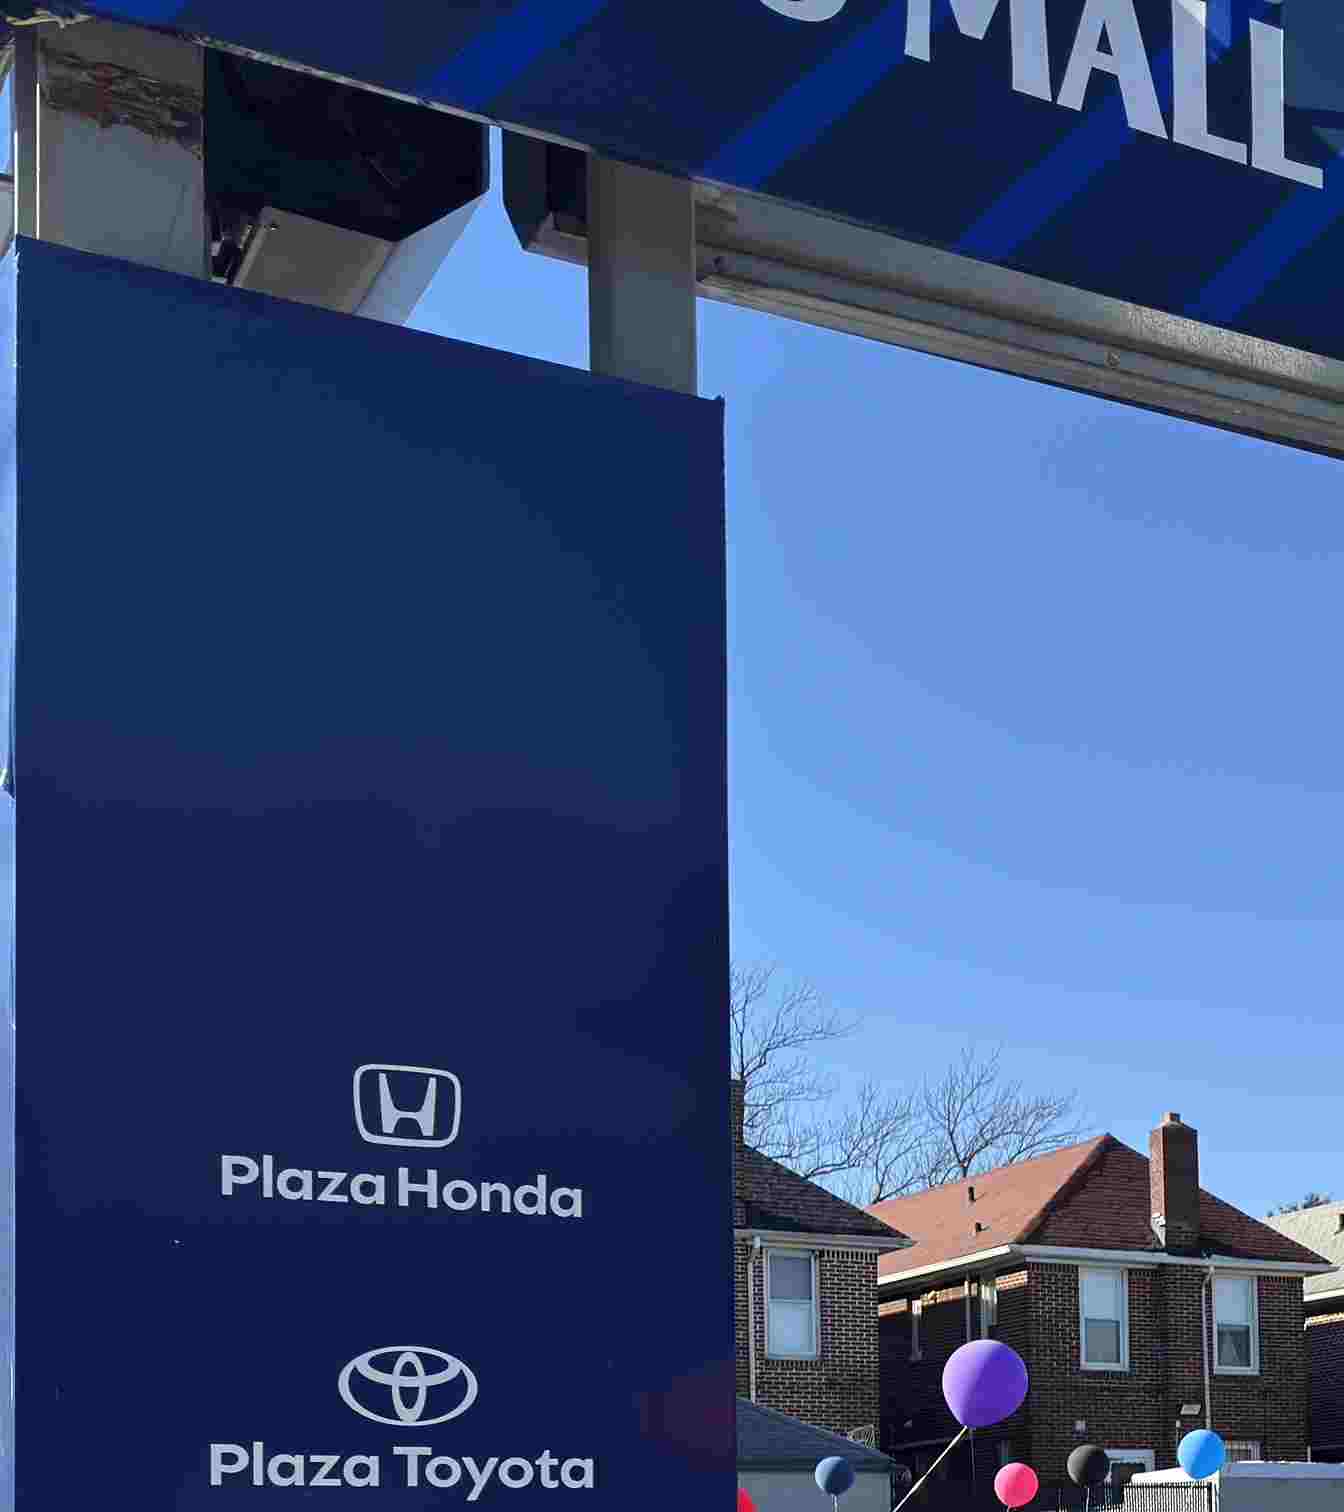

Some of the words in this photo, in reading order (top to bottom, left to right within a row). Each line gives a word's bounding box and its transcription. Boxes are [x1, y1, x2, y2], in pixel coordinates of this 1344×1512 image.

[221, 1155, 385, 1205] Plaza
[398, 1168, 582, 1218] Honda
[210, 1442, 380, 1487] Plaza
[393, 1446, 594, 1502] Toyota
